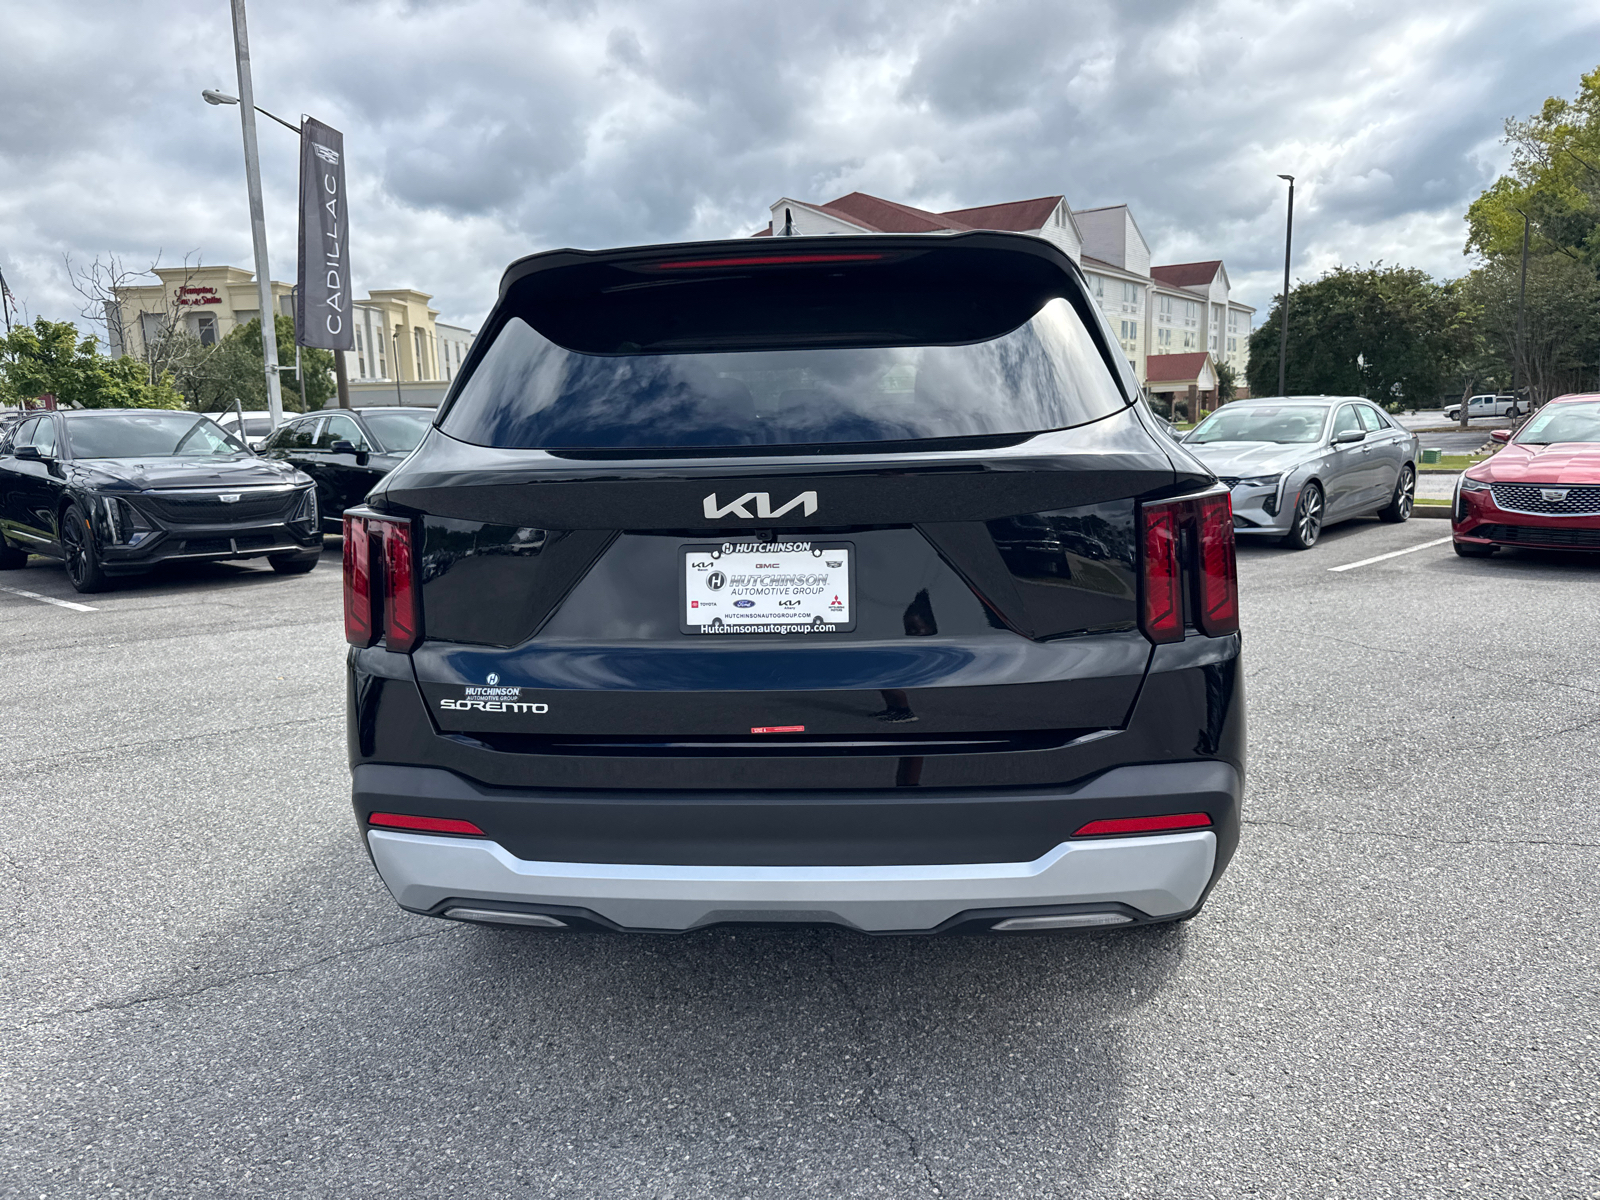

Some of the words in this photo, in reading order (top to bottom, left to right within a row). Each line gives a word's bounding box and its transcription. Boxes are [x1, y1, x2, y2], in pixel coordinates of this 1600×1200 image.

[324, 173, 342, 334] CADILLAC
[735, 542, 812, 553] HUTCHINSON
[729, 574, 829, 588] HUTCHINSON
[731, 587, 790, 596] AUTOMOTIVE
[792, 587, 825, 595] GROUP
[736, 600, 753, 608] Ford
[700, 624, 836, 634] Hutchinsonautogroup.com
[465, 687, 520, 696] HUTCHINSON
[440, 699, 549, 714] SORENTO
